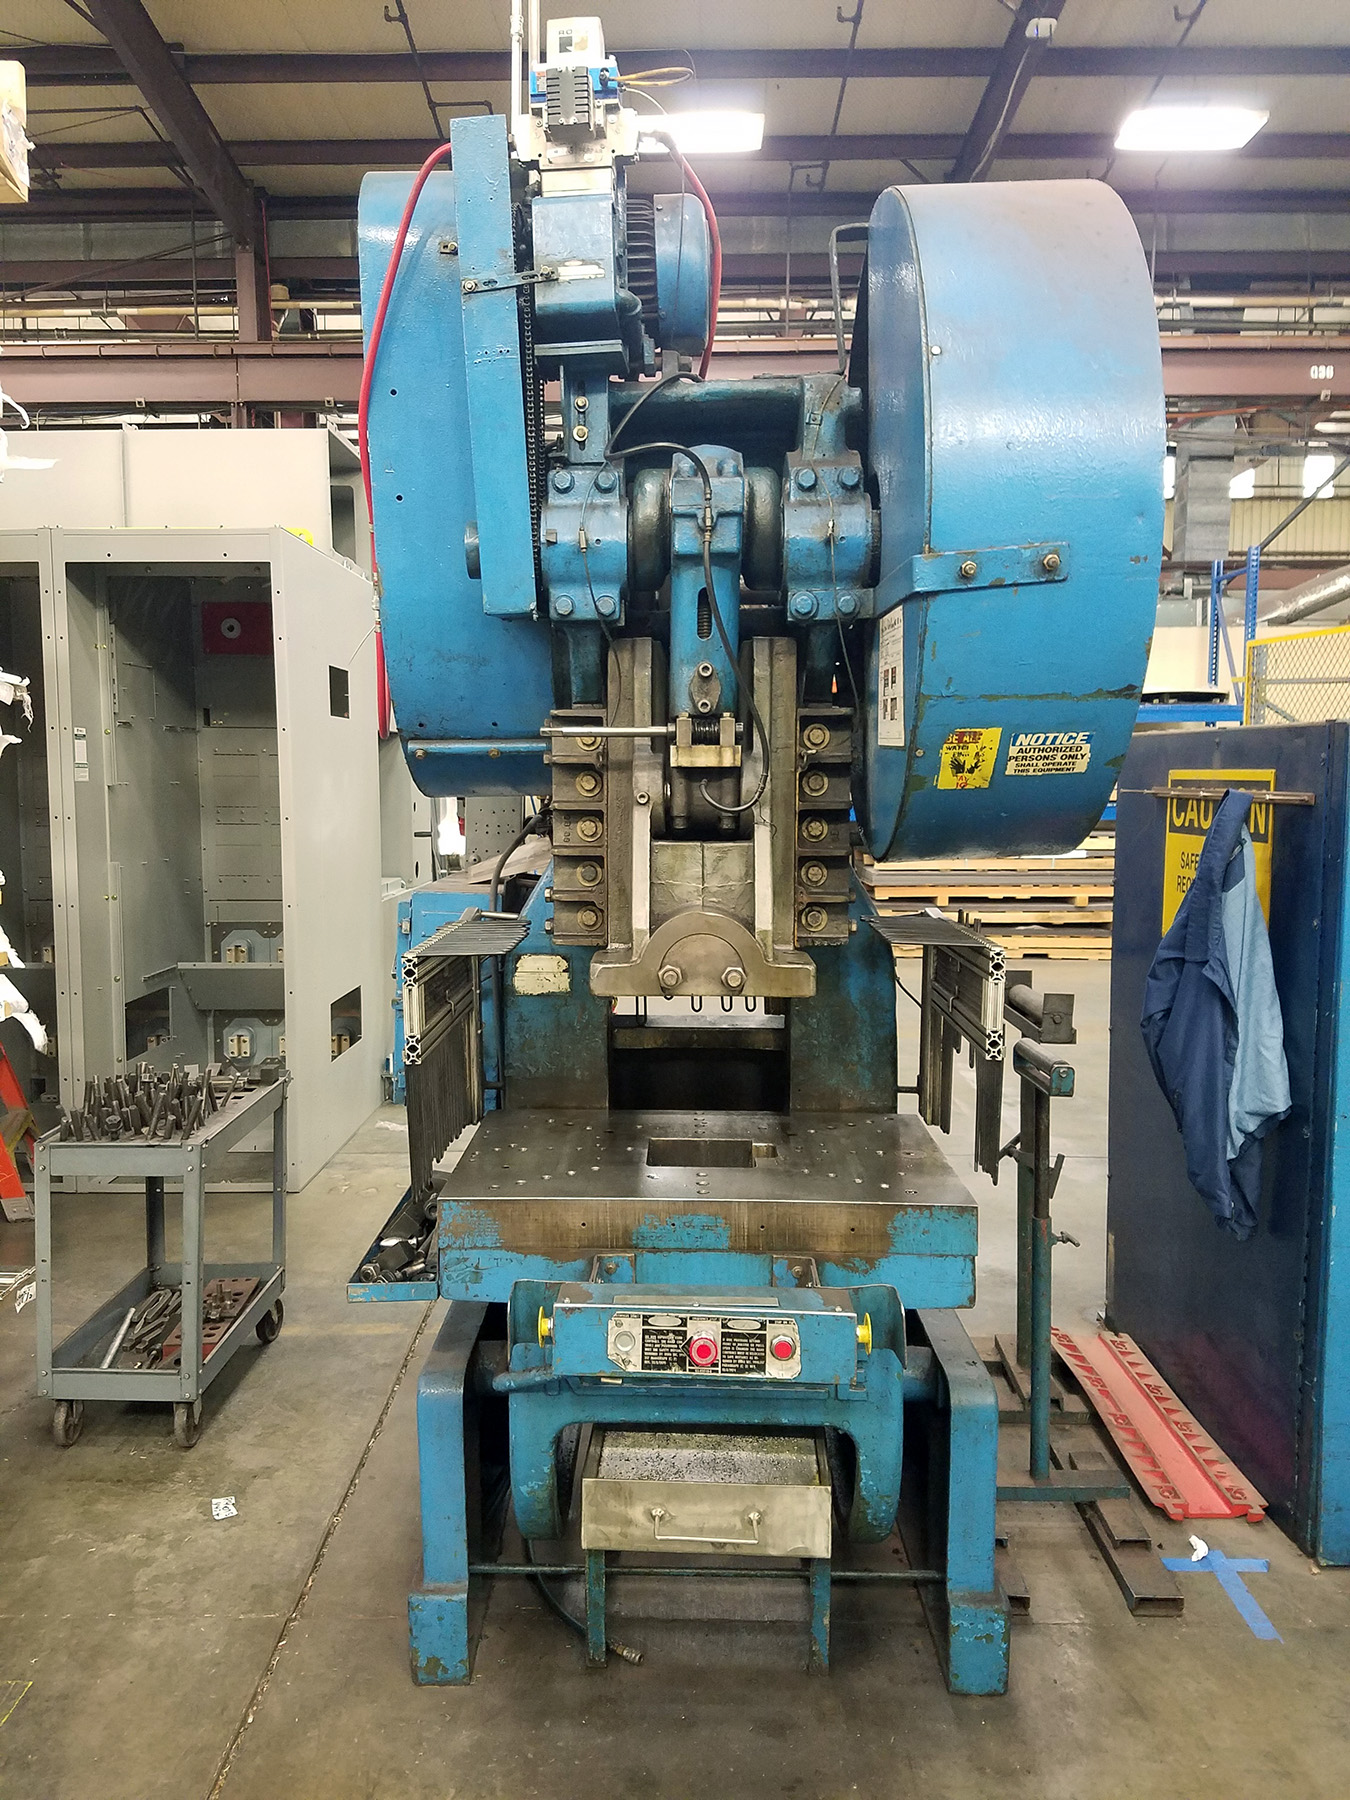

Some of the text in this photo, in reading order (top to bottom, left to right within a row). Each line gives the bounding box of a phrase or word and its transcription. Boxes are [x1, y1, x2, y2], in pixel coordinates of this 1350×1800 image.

[1015, 732, 1090, 746] NOTICE
[1017, 746, 1083, 754] AUTHORIZED
[1008, 753, 1088, 762] PERSONS ONLY
[1172, 786, 1266, 834] CAUN
[1180, 851, 1200, 870] SAFE
